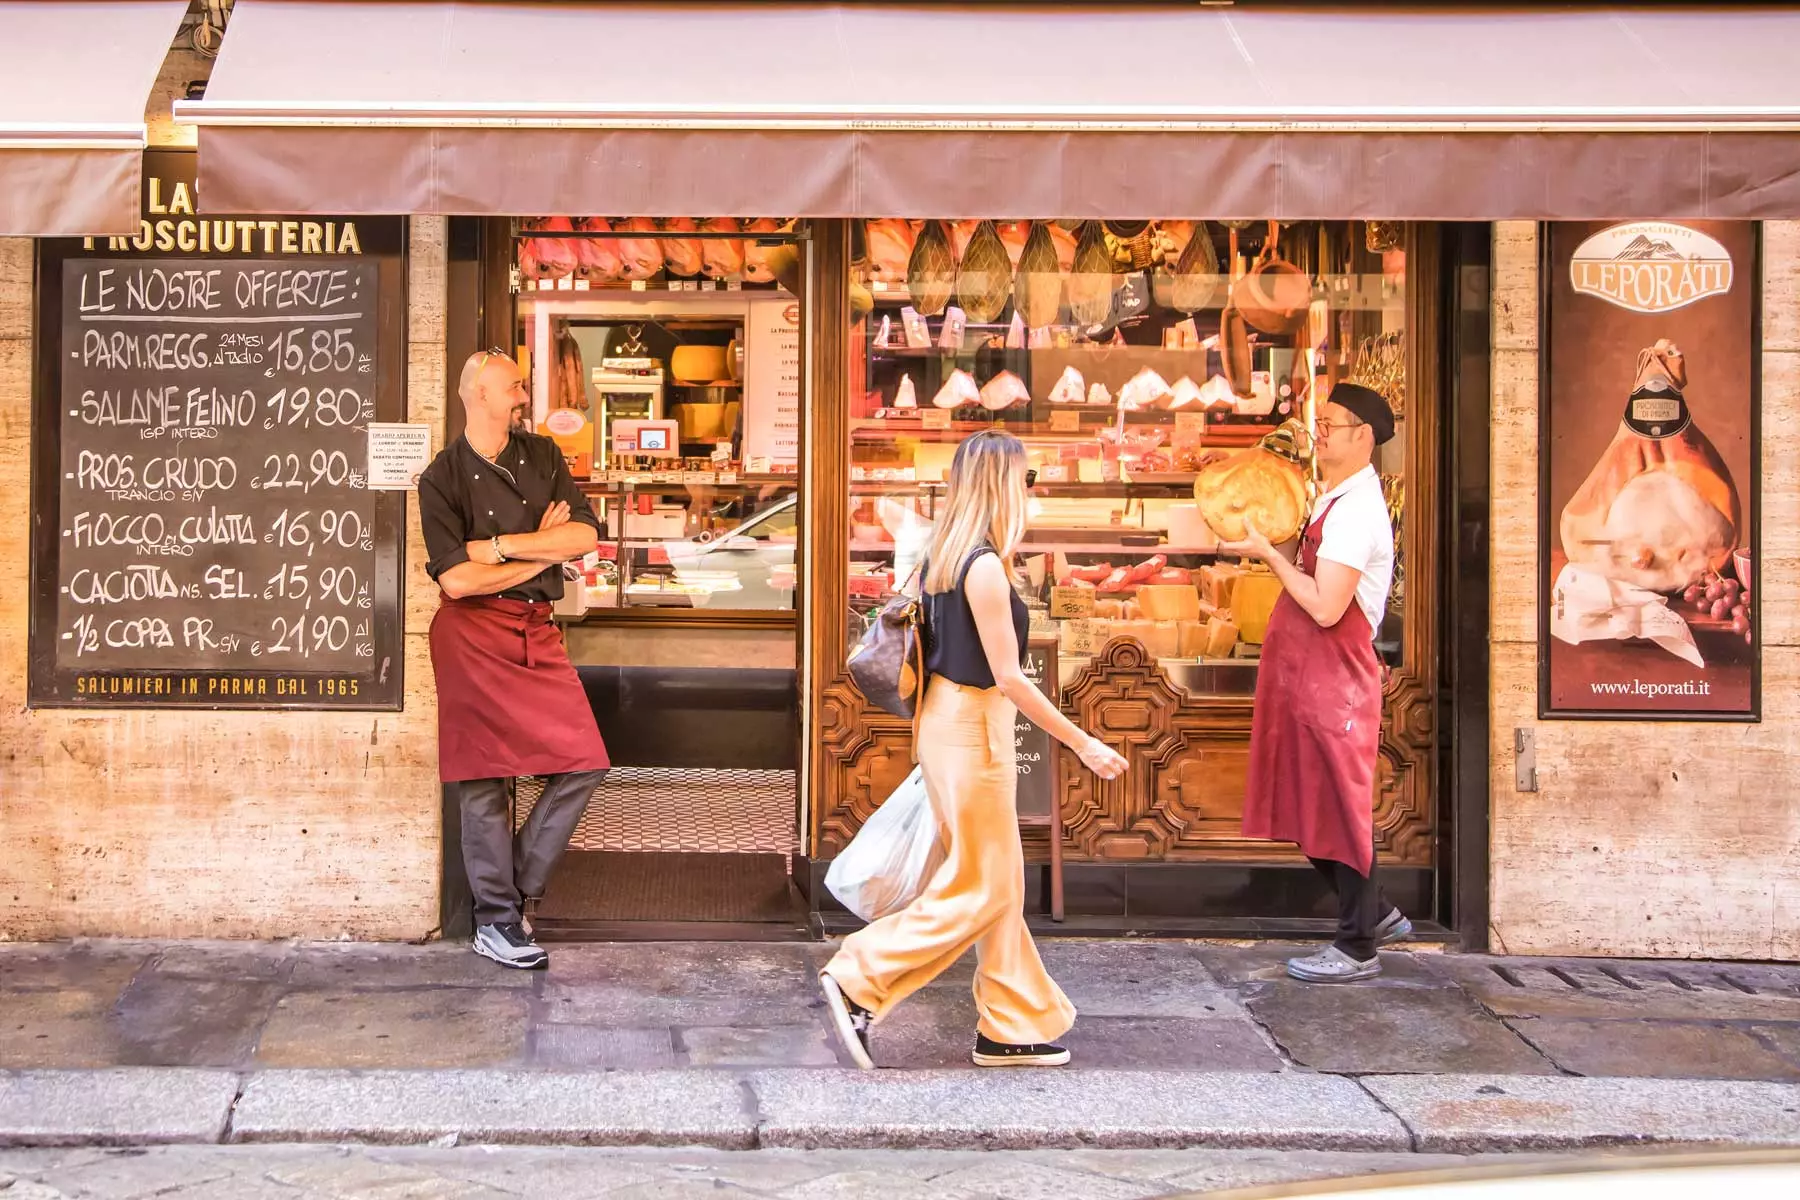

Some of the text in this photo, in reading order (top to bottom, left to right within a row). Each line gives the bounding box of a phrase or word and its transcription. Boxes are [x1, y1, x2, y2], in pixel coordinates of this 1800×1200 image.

[149, 177, 194, 214] LA
[1611, 225, 1692, 239] PROSCIUTTI
[80, 267, 362, 312] LE NOSTRE OFFERTE:
[1581, 262, 1725, 306] LEPORATI
[140, 427, 219, 440] IGP INTERO
[143, 456, 237, 490] CRUDO
[105, 489, 175, 501] TRANCIO
[165, 535, 177, 546] DI
[179, 506, 257, 545] CULATTA
[136, 545, 194, 557] INTERO
[360, 540, 373, 551] KG
[204, 564, 258, 600] SEL.
[356, 597, 372, 609] KG
[105, 617, 174, 649] COPPA
[183, 616, 219, 651] PR
[355, 643, 375, 657] KG
[77, 677, 358, 696] SALUMIERI IN PARMA DAL 1965
[1591, 679, 1711, 698] www.leporati.it
